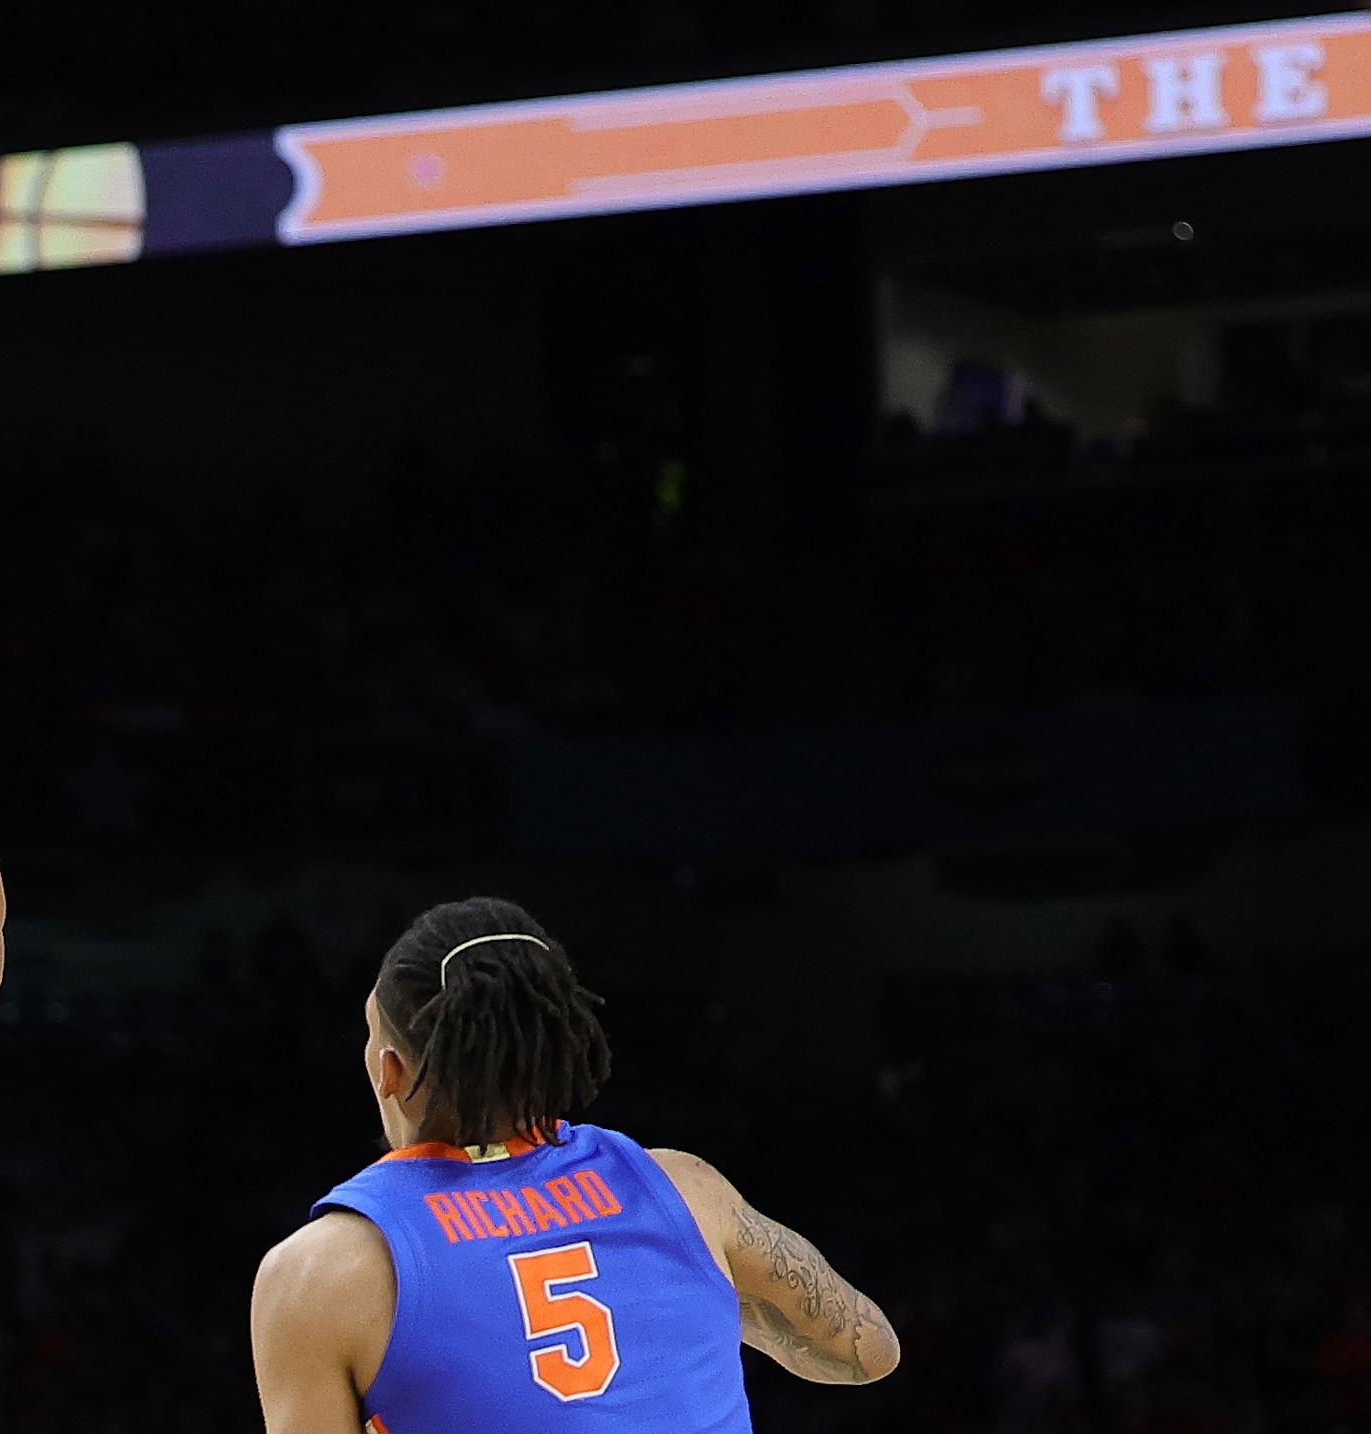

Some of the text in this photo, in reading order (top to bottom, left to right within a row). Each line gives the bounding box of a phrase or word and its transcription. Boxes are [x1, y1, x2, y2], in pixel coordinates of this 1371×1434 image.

[1041, 42, 1328, 144] THE
[424, 1170, 622, 1243] RICHARD
[508, 1240, 621, 1402] 5
